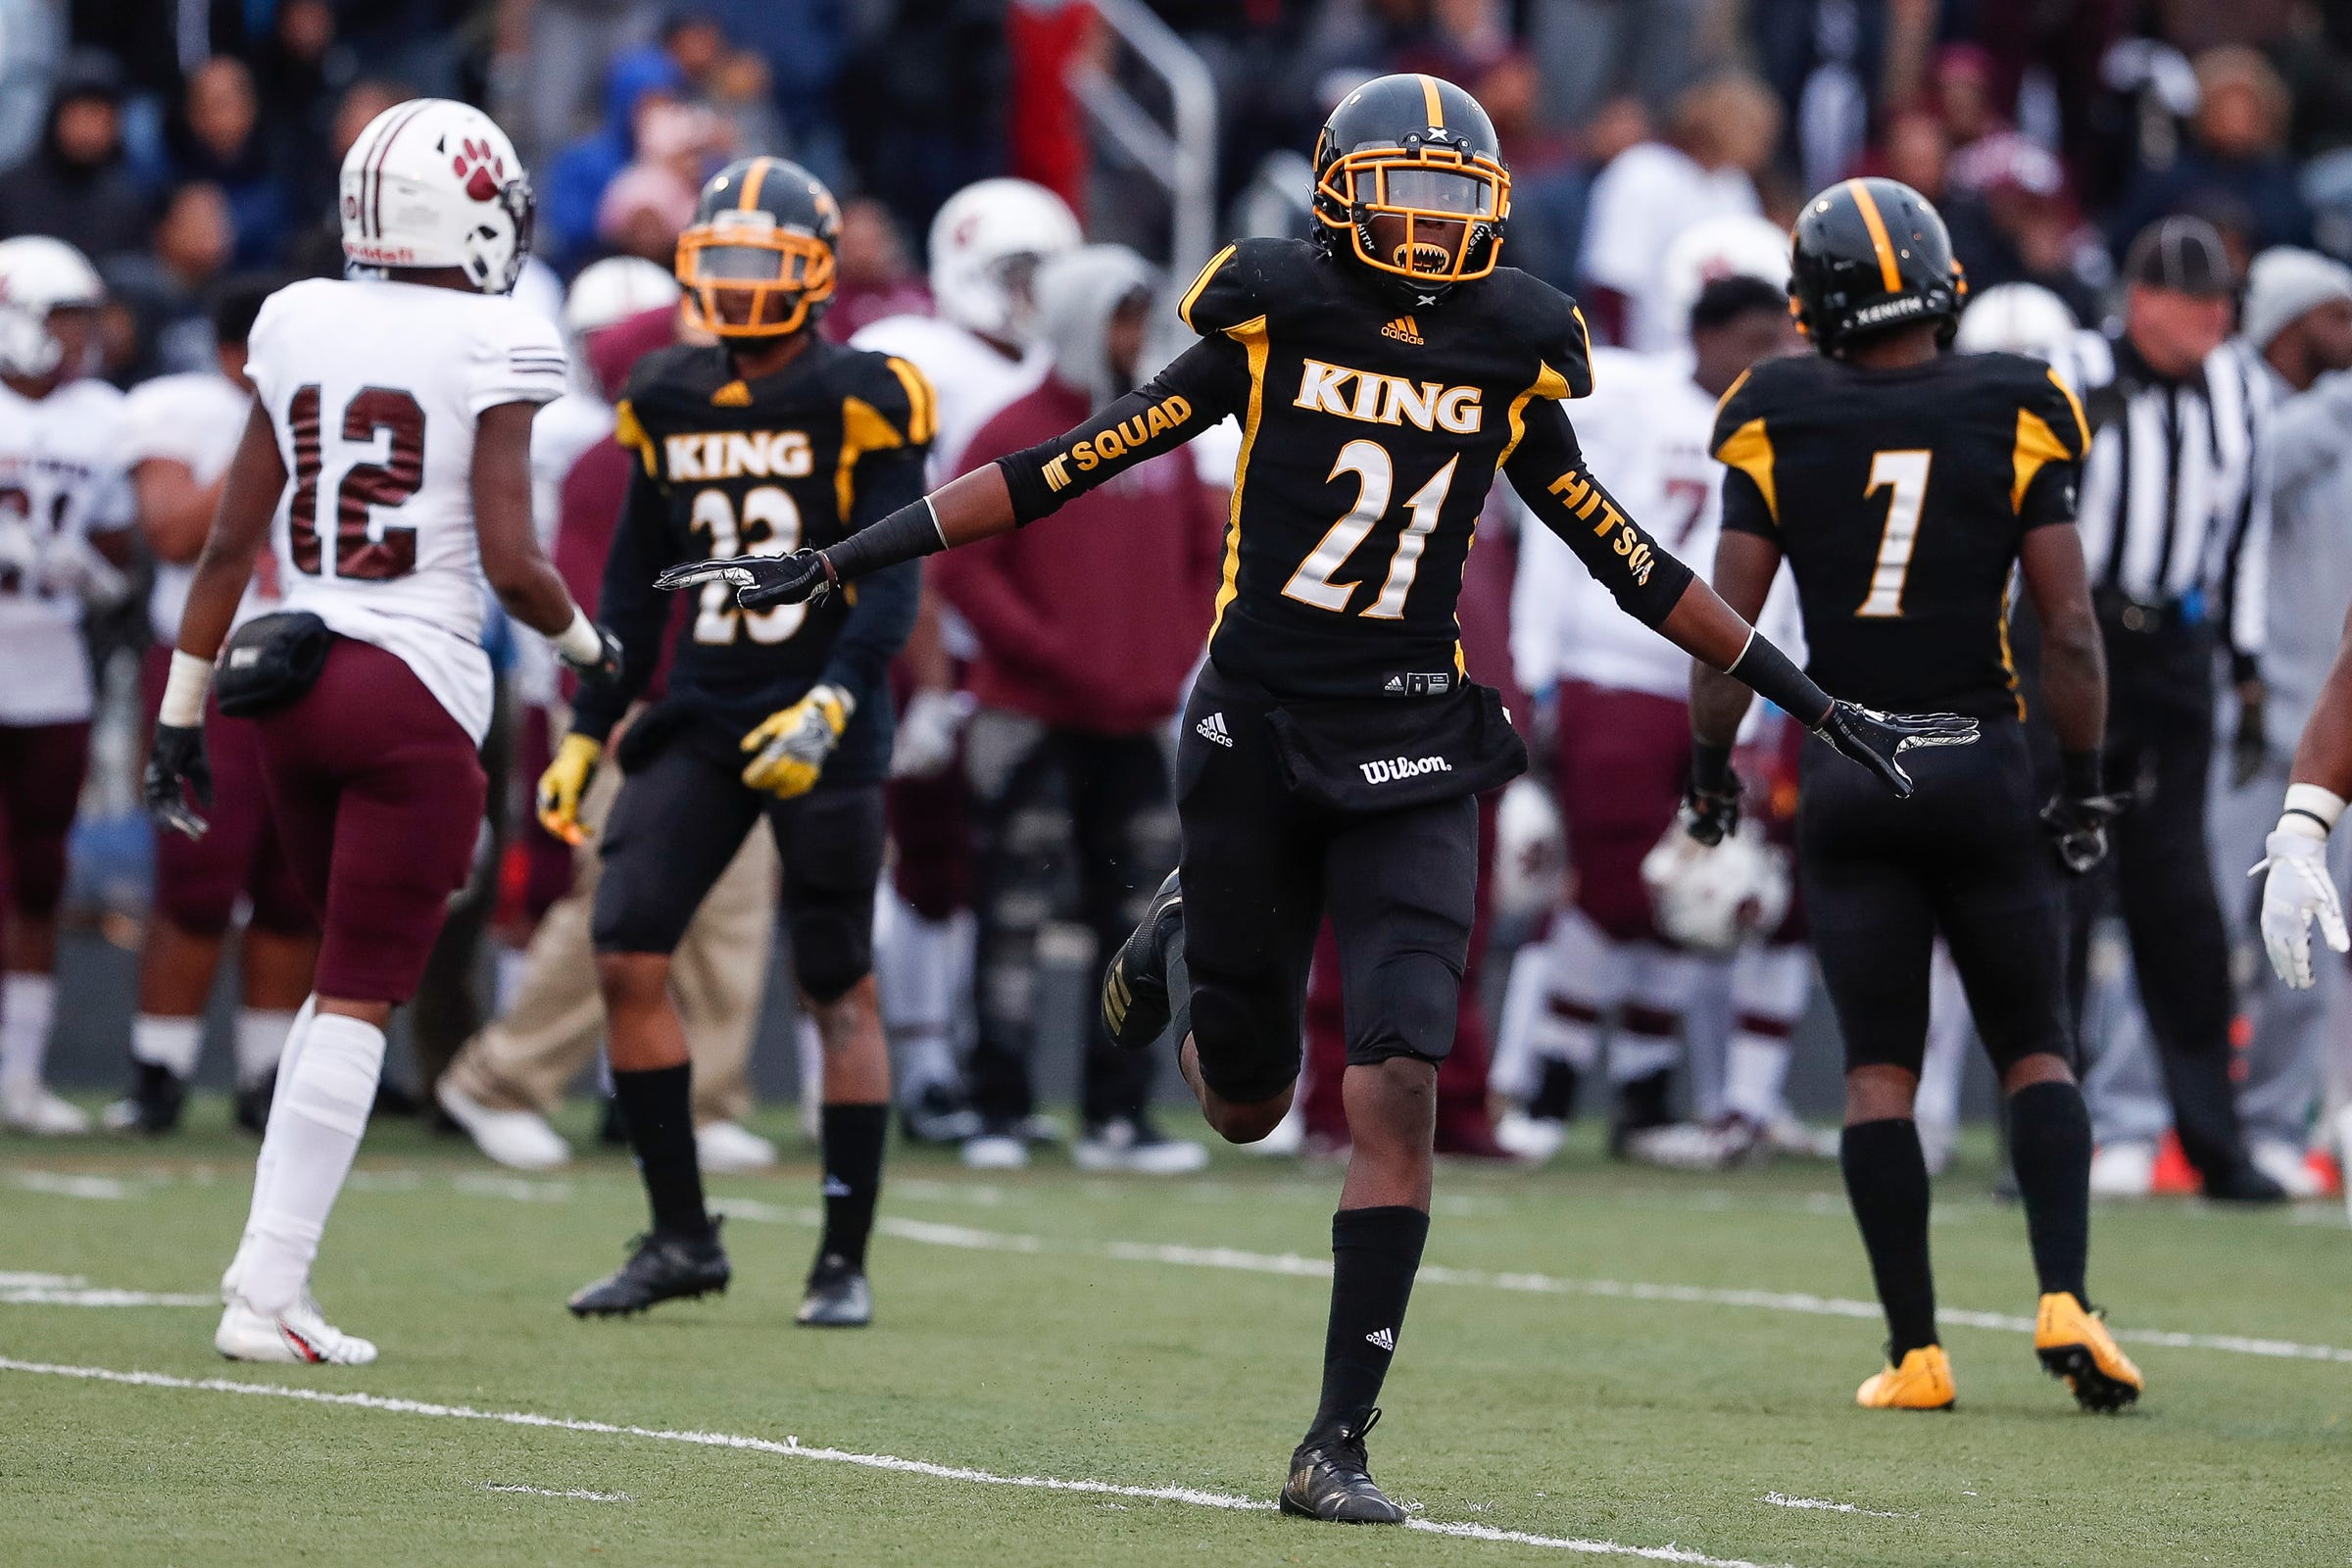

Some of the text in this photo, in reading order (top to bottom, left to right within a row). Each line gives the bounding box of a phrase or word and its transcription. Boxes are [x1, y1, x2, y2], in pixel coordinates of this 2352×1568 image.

[1356, 223, 1376, 250] NITH
[1380, 321, 1425, 346] adidas
[1855, 295, 1923, 326] XENITH
[1292, 357, 1483, 434] KING
[663, 429, 815, 482] KING
[287, 384, 425, 581] 12
[1280, 438, 1460, 620] 21
[1854, 448, 1934, 617] 7
[689, 485, 808, 646] 23
[1196, 721, 1233, 748] adidas
[1365, 1333, 1394, 1351] adida
